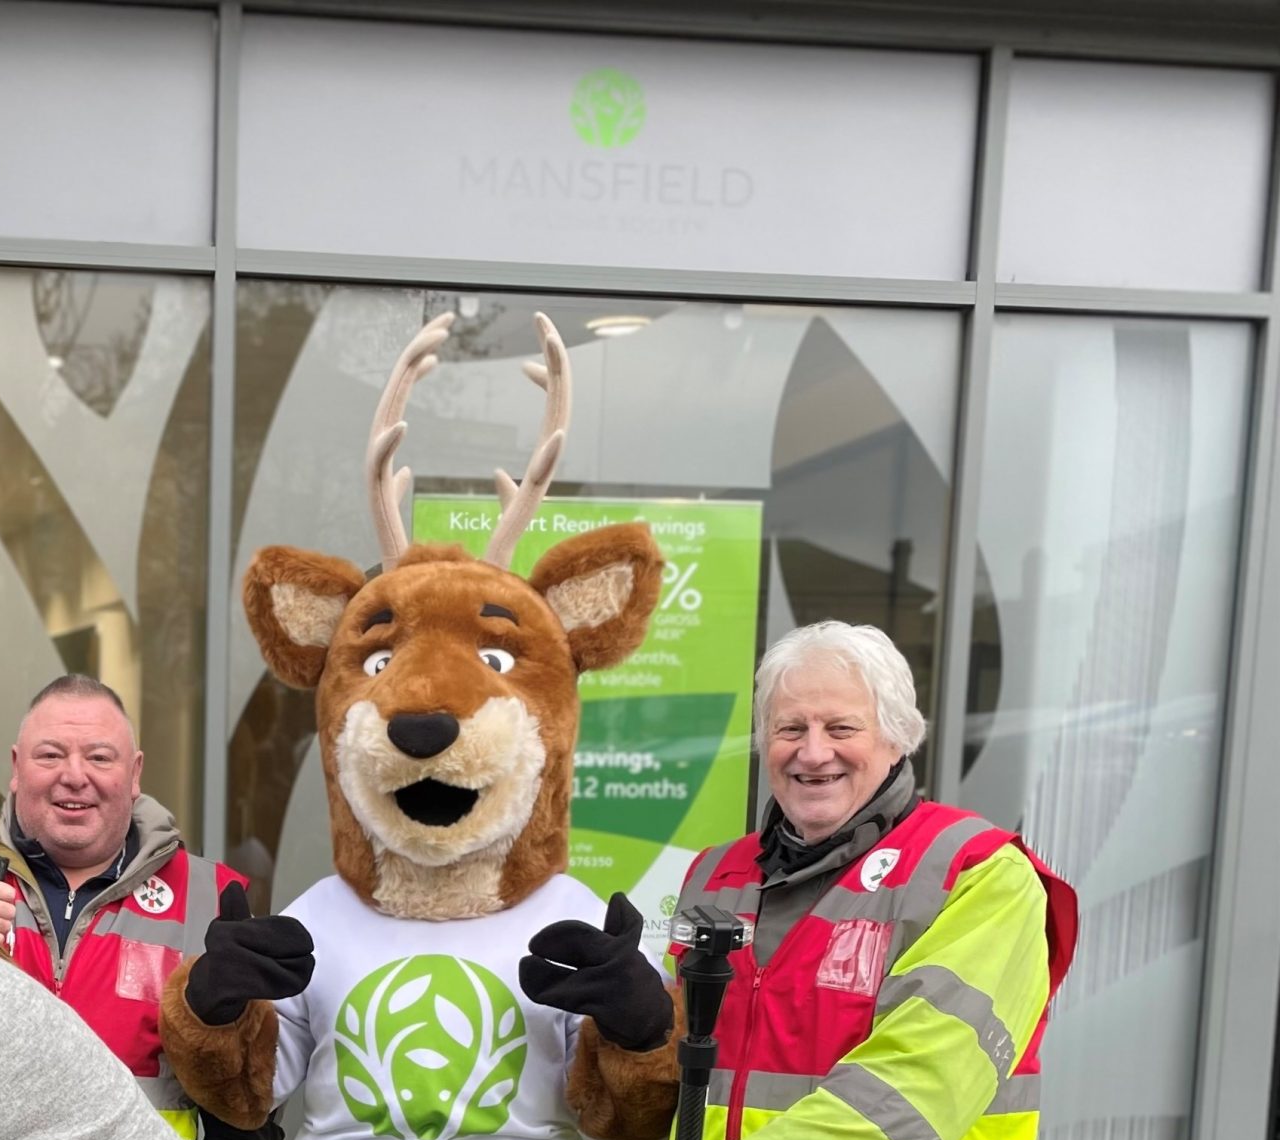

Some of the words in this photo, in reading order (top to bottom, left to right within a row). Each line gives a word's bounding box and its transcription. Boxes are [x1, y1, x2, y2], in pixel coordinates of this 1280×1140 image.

[458, 154, 756, 209] MANSFIELD
[449, 512, 491, 531] Kick
[573, 745, 662, 774] savings,
[572, 776, 599, 799] 12
[604, 778, 688, 799] months
